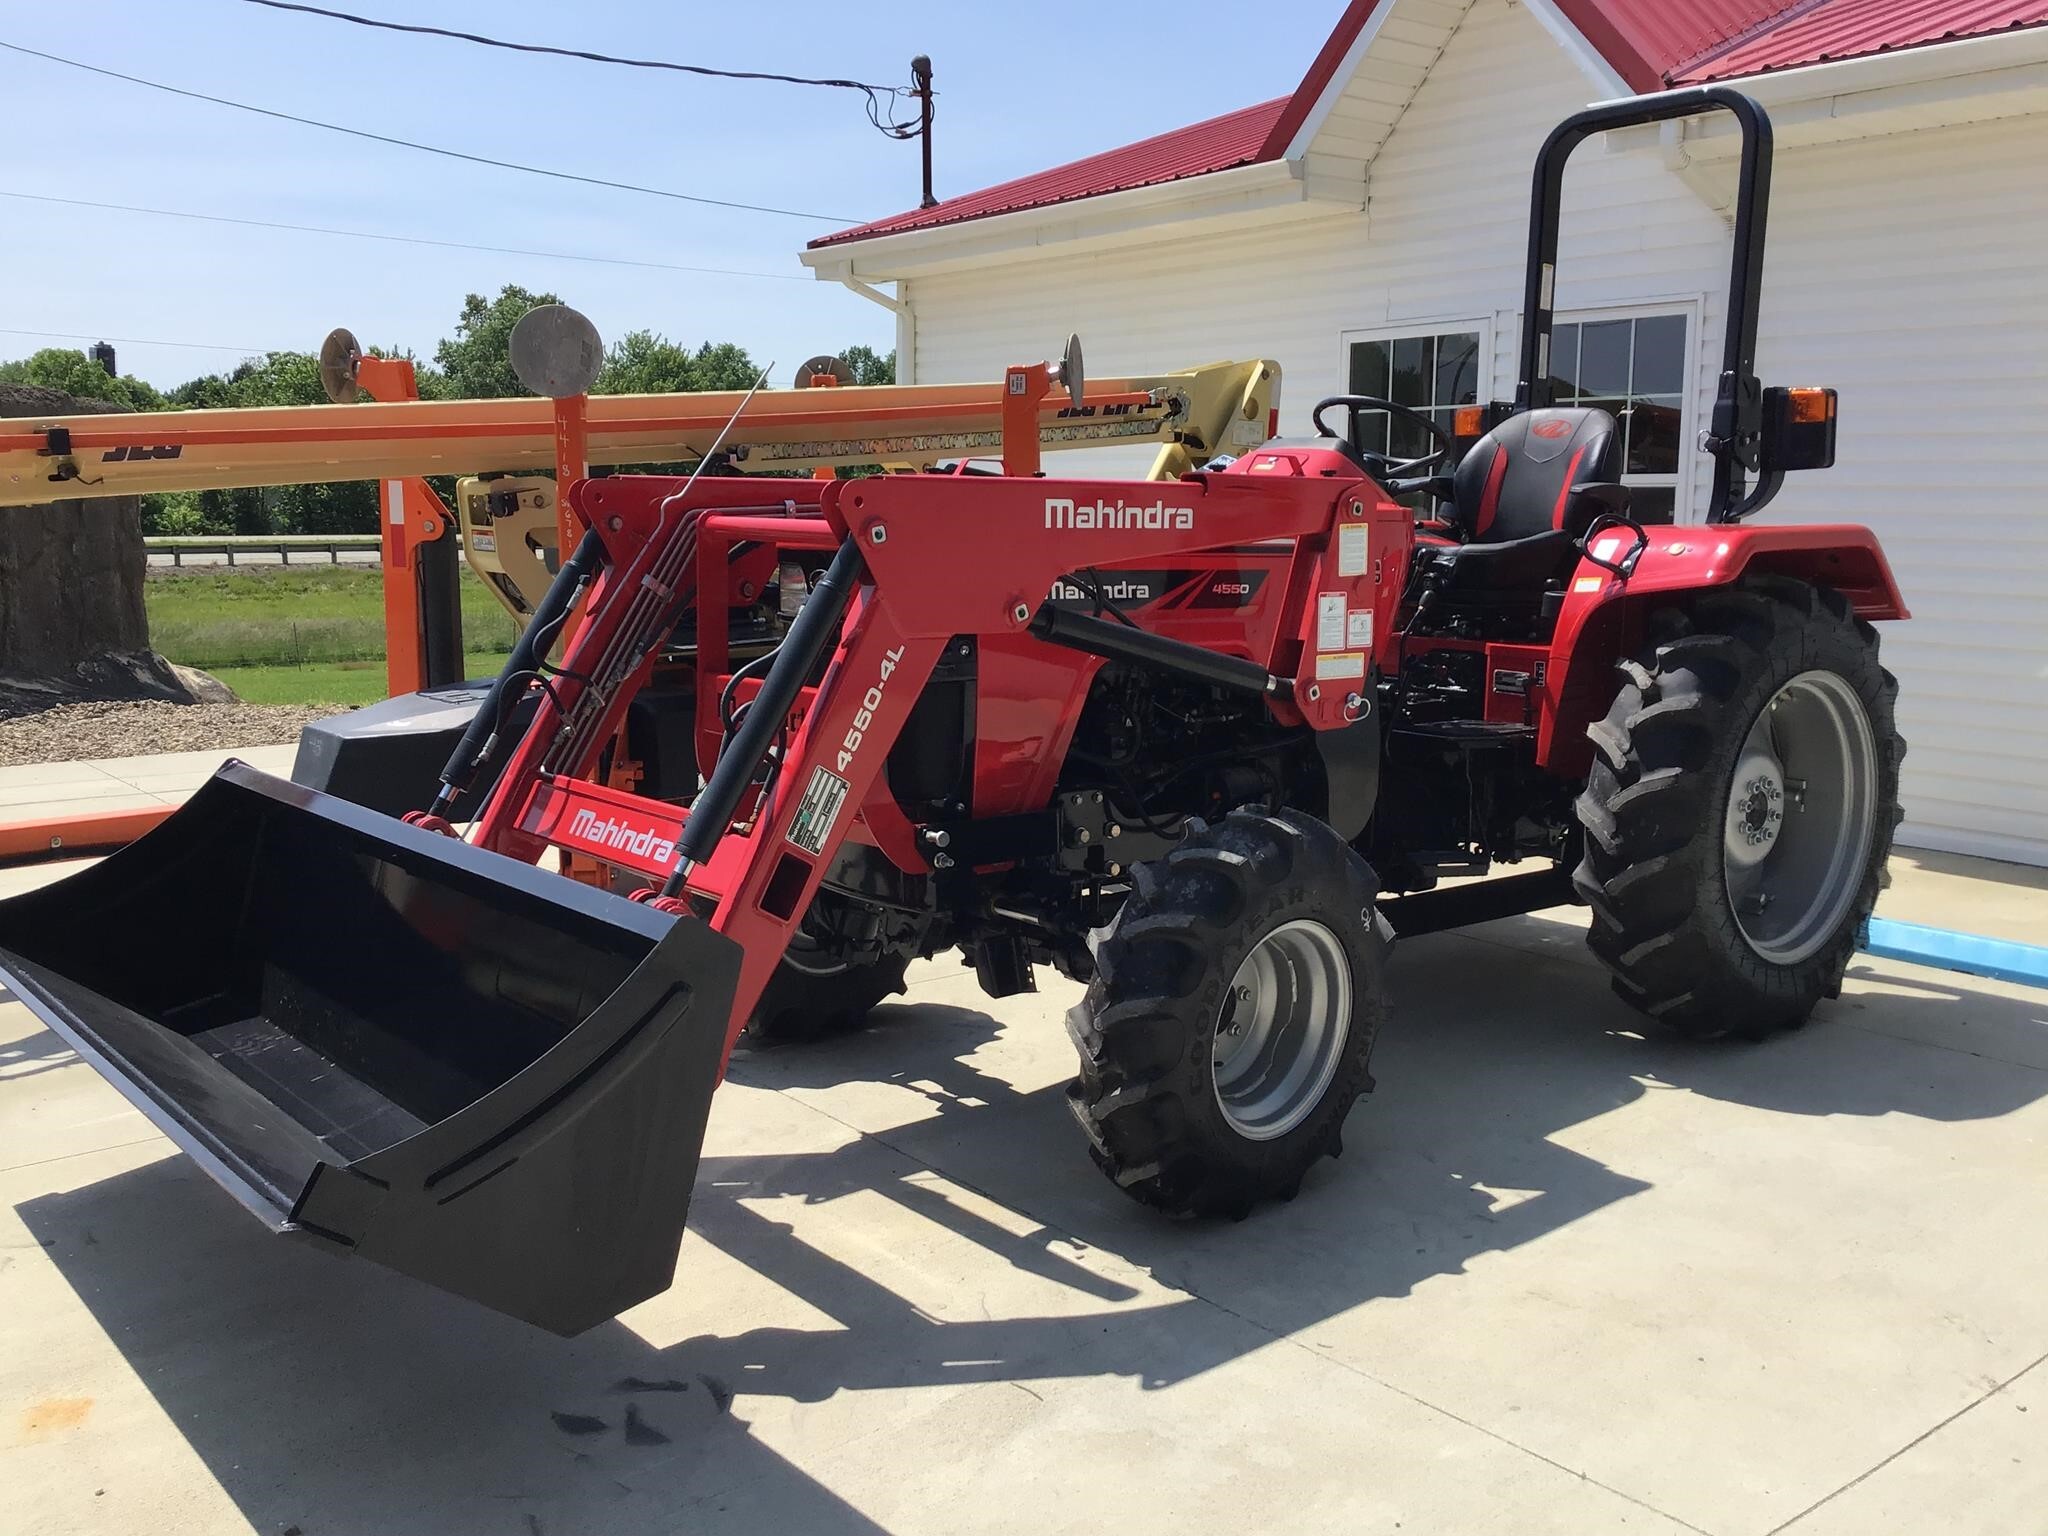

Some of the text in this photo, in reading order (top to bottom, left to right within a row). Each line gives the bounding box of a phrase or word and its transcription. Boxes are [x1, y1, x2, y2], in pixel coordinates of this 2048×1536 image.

[1045, 499, 1193, 529] Mahindra
[1212, 584, 1249, 594] 4550
[837, 645, 905, 772] 4550-4L
[569, 808, 674, 863] Mahindra
